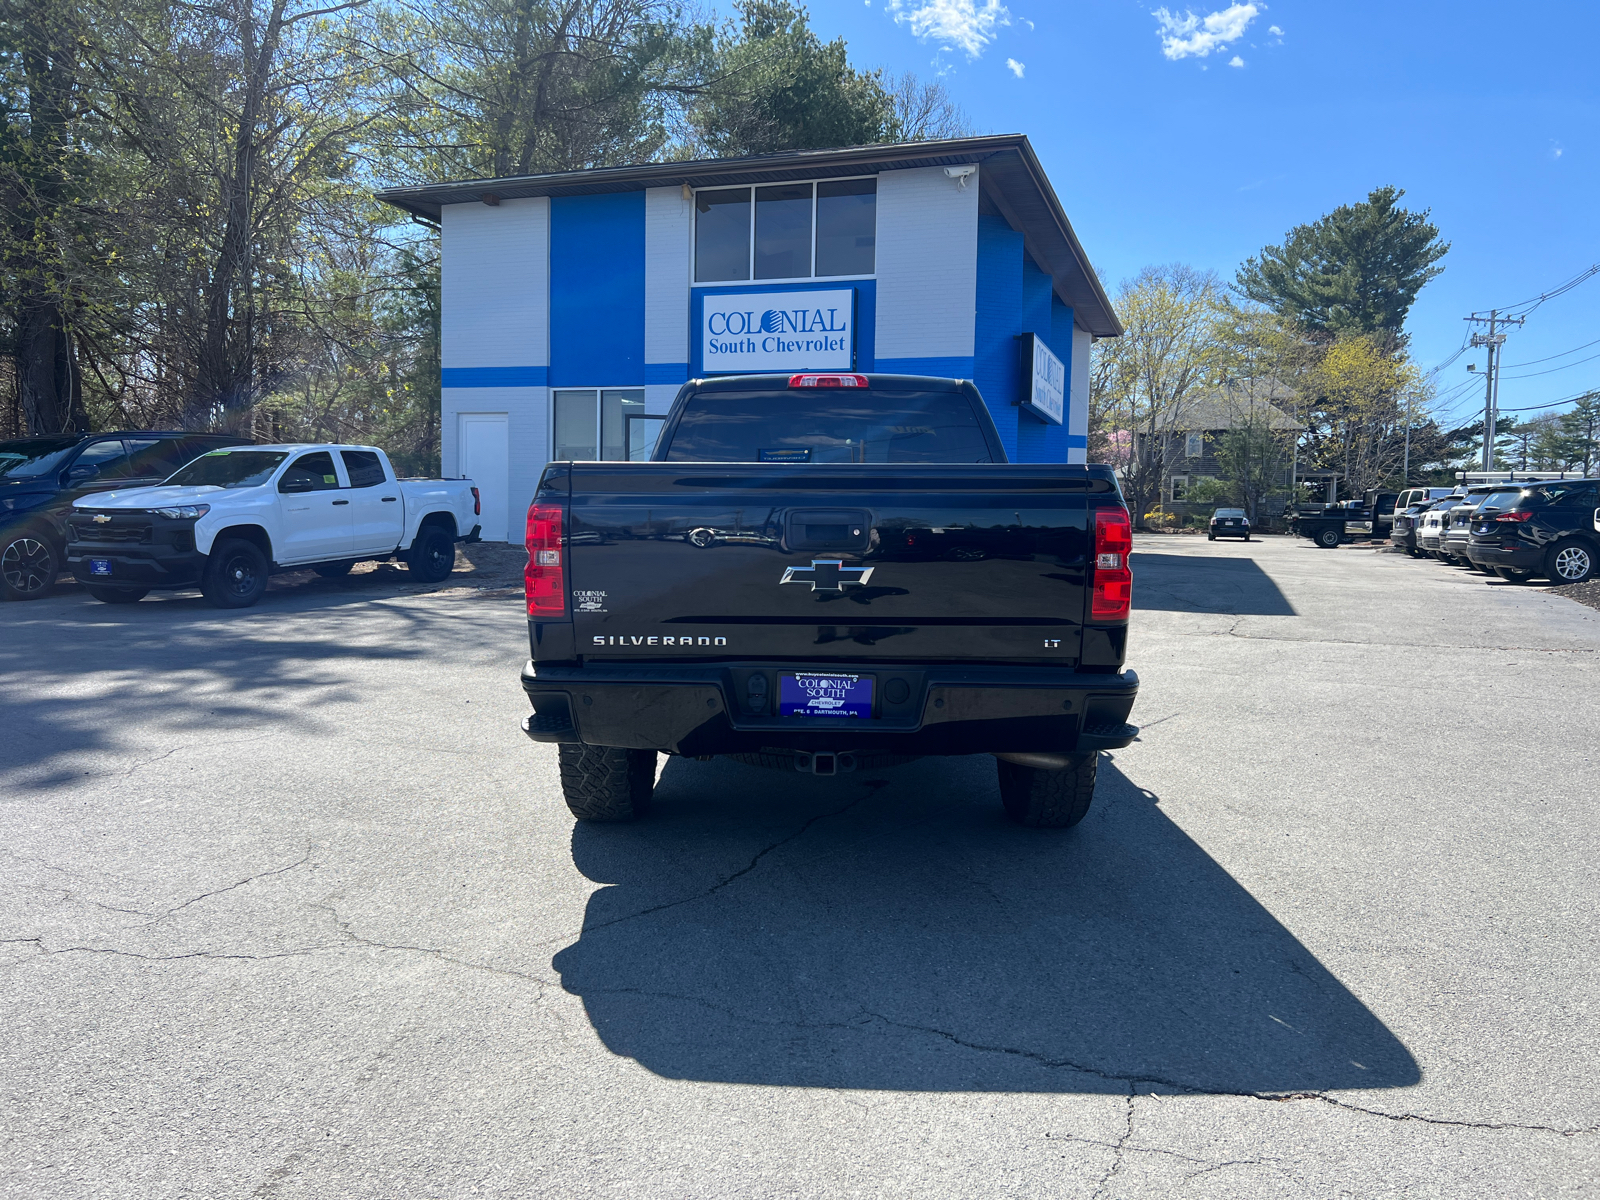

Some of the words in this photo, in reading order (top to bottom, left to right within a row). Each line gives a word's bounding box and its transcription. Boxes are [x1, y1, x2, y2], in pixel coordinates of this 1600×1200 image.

[708, 308, 846, 335] COLONIAL
[709, 337, 756, 354] South
[762, 335, 846, 353] Chevrolet
[592, 635, 728, 647] SILVERADO
[1044, 639, 1062, 648] LT
[798, 679, 855, 690] COLONIAL
[806, 689, 845, 698] SOUTH
